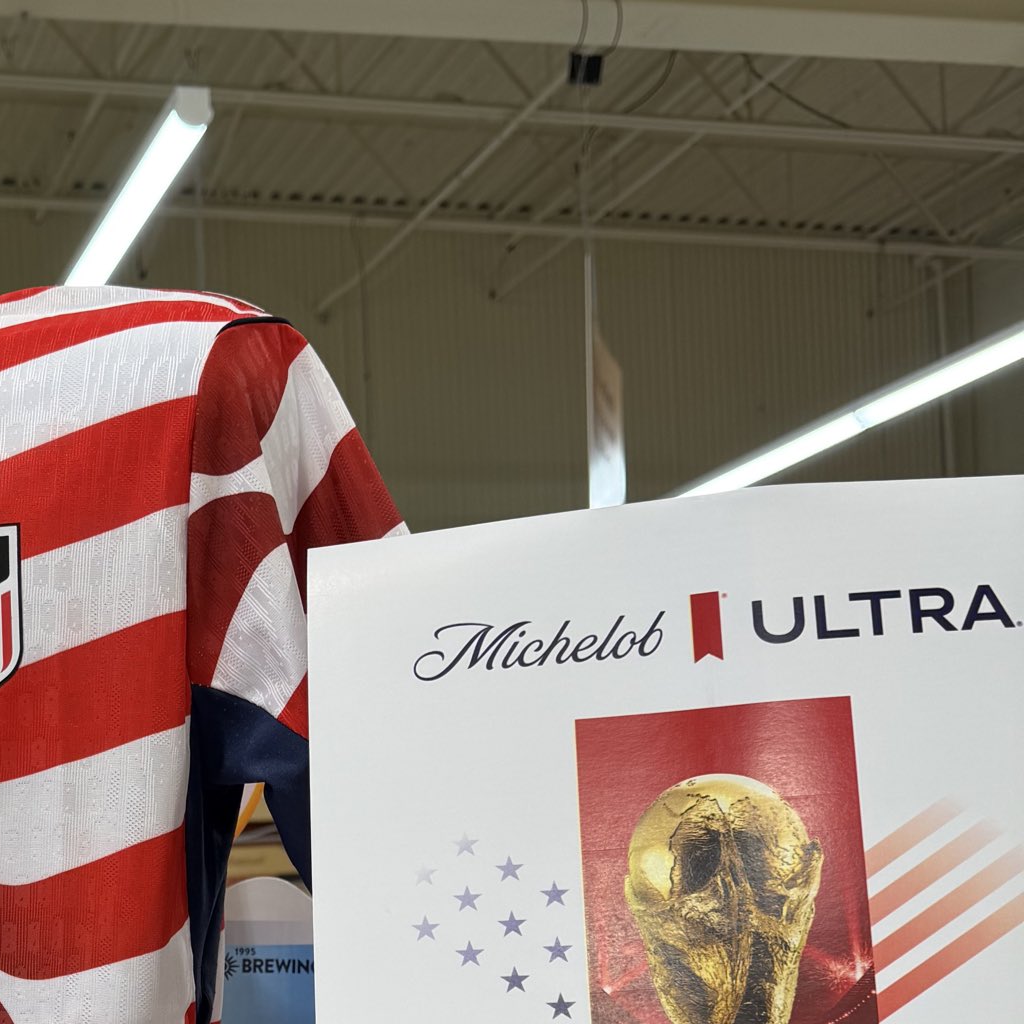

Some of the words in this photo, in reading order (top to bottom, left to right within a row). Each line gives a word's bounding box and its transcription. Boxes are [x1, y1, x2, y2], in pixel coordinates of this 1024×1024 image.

[413, 610, 667, 681] Michelob
[751, 584, 1017, 644] ULTRA
[234, 948, 256, 956] 1995
